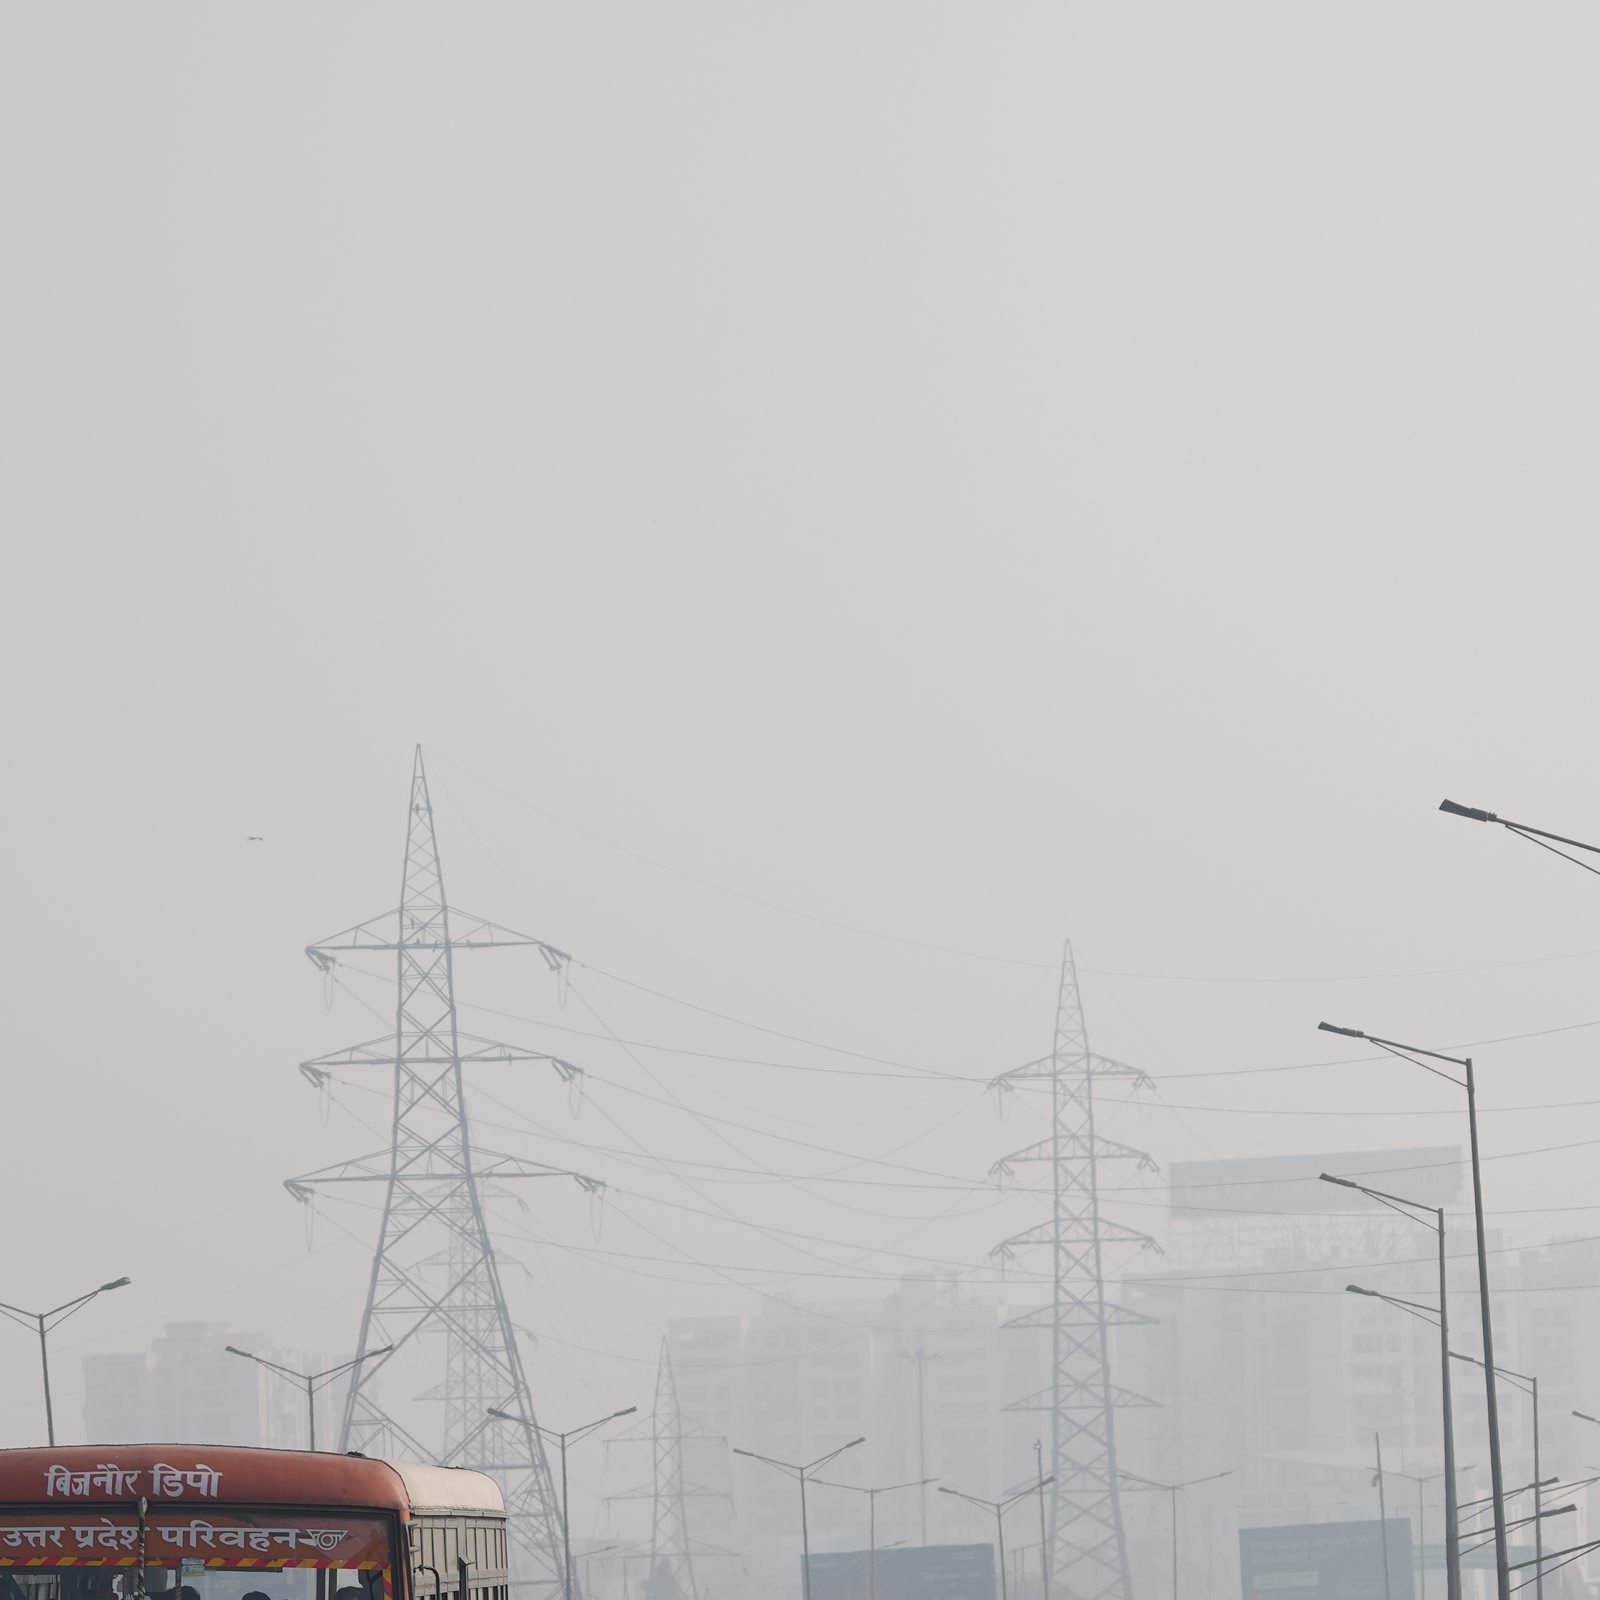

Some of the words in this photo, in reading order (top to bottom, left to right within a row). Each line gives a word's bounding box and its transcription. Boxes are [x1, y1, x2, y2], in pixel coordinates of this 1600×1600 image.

[43, 1464, 142, 1497] बिजनौर
[147, 1463, 224, 1498] डिपो
[70, 1518, 150, 1551] प्रदेश
[156, 1520, 302, 1552] परिवहन
